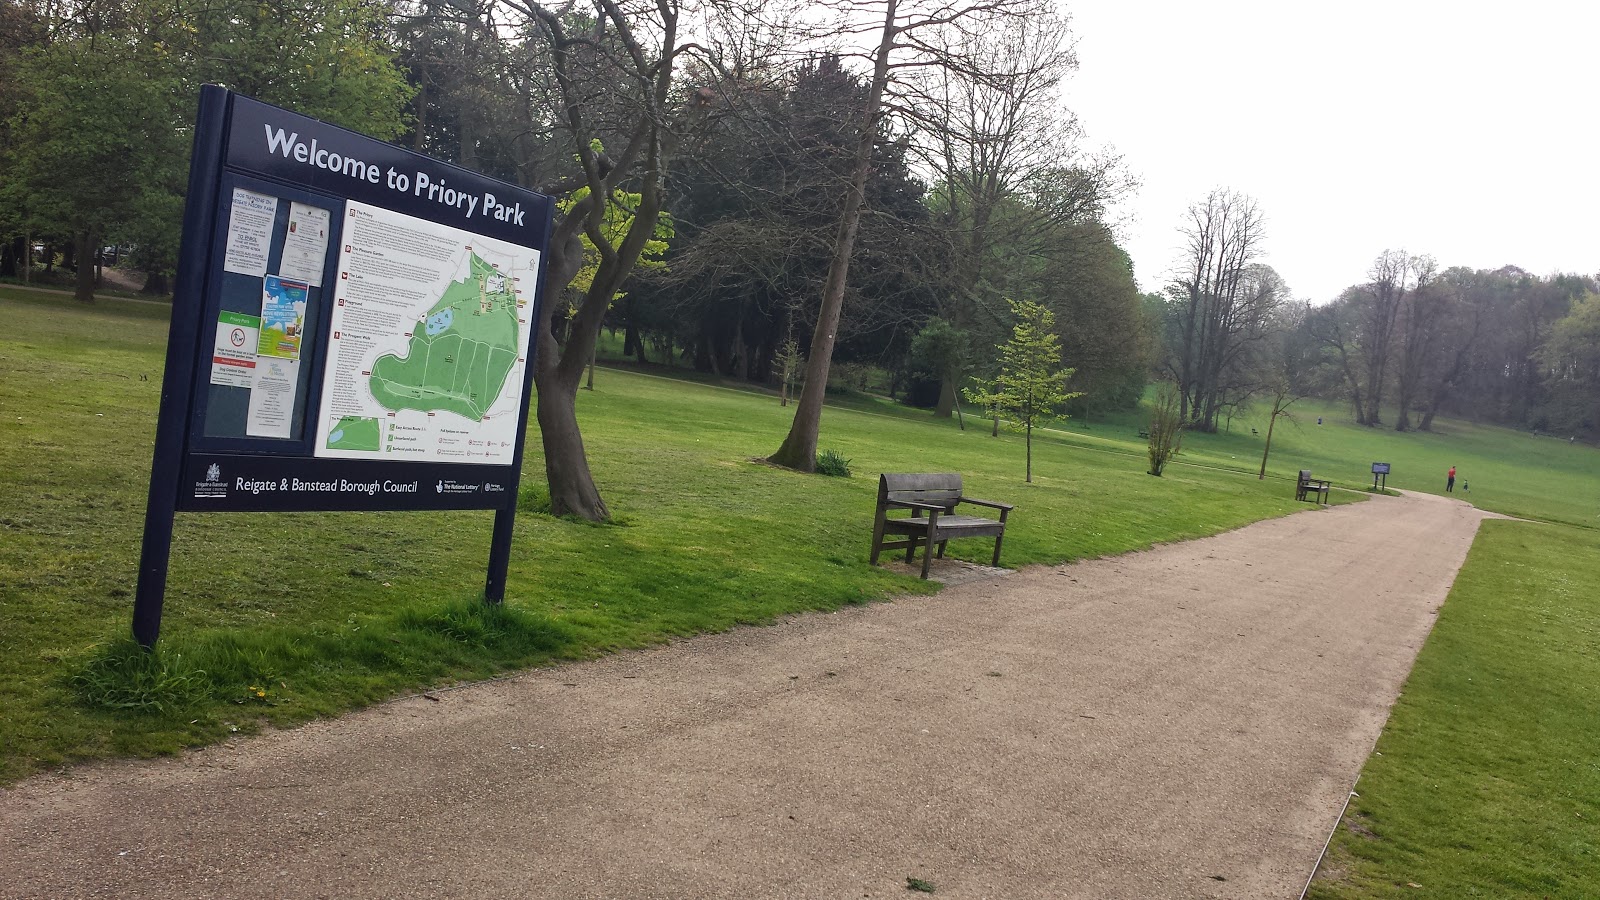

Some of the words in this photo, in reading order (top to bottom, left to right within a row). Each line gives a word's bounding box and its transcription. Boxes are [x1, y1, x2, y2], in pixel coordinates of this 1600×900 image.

[264, 123, 380, 184] Welcome
[387, 166, 410, 193] to
[414, 171, 478, 218] Priory
[482, 193, 526, 227] Park
[363, 211, 374, 219] Priory
[229, 316, 241, 324] Priory
[235, 477, 277, 494] Reigate
[279, 478, 289, 491] &
[291, 478, 338, 492] Banstead
[339, 479, 380, 496] Borough
[383, 479, 418, 493] Council
